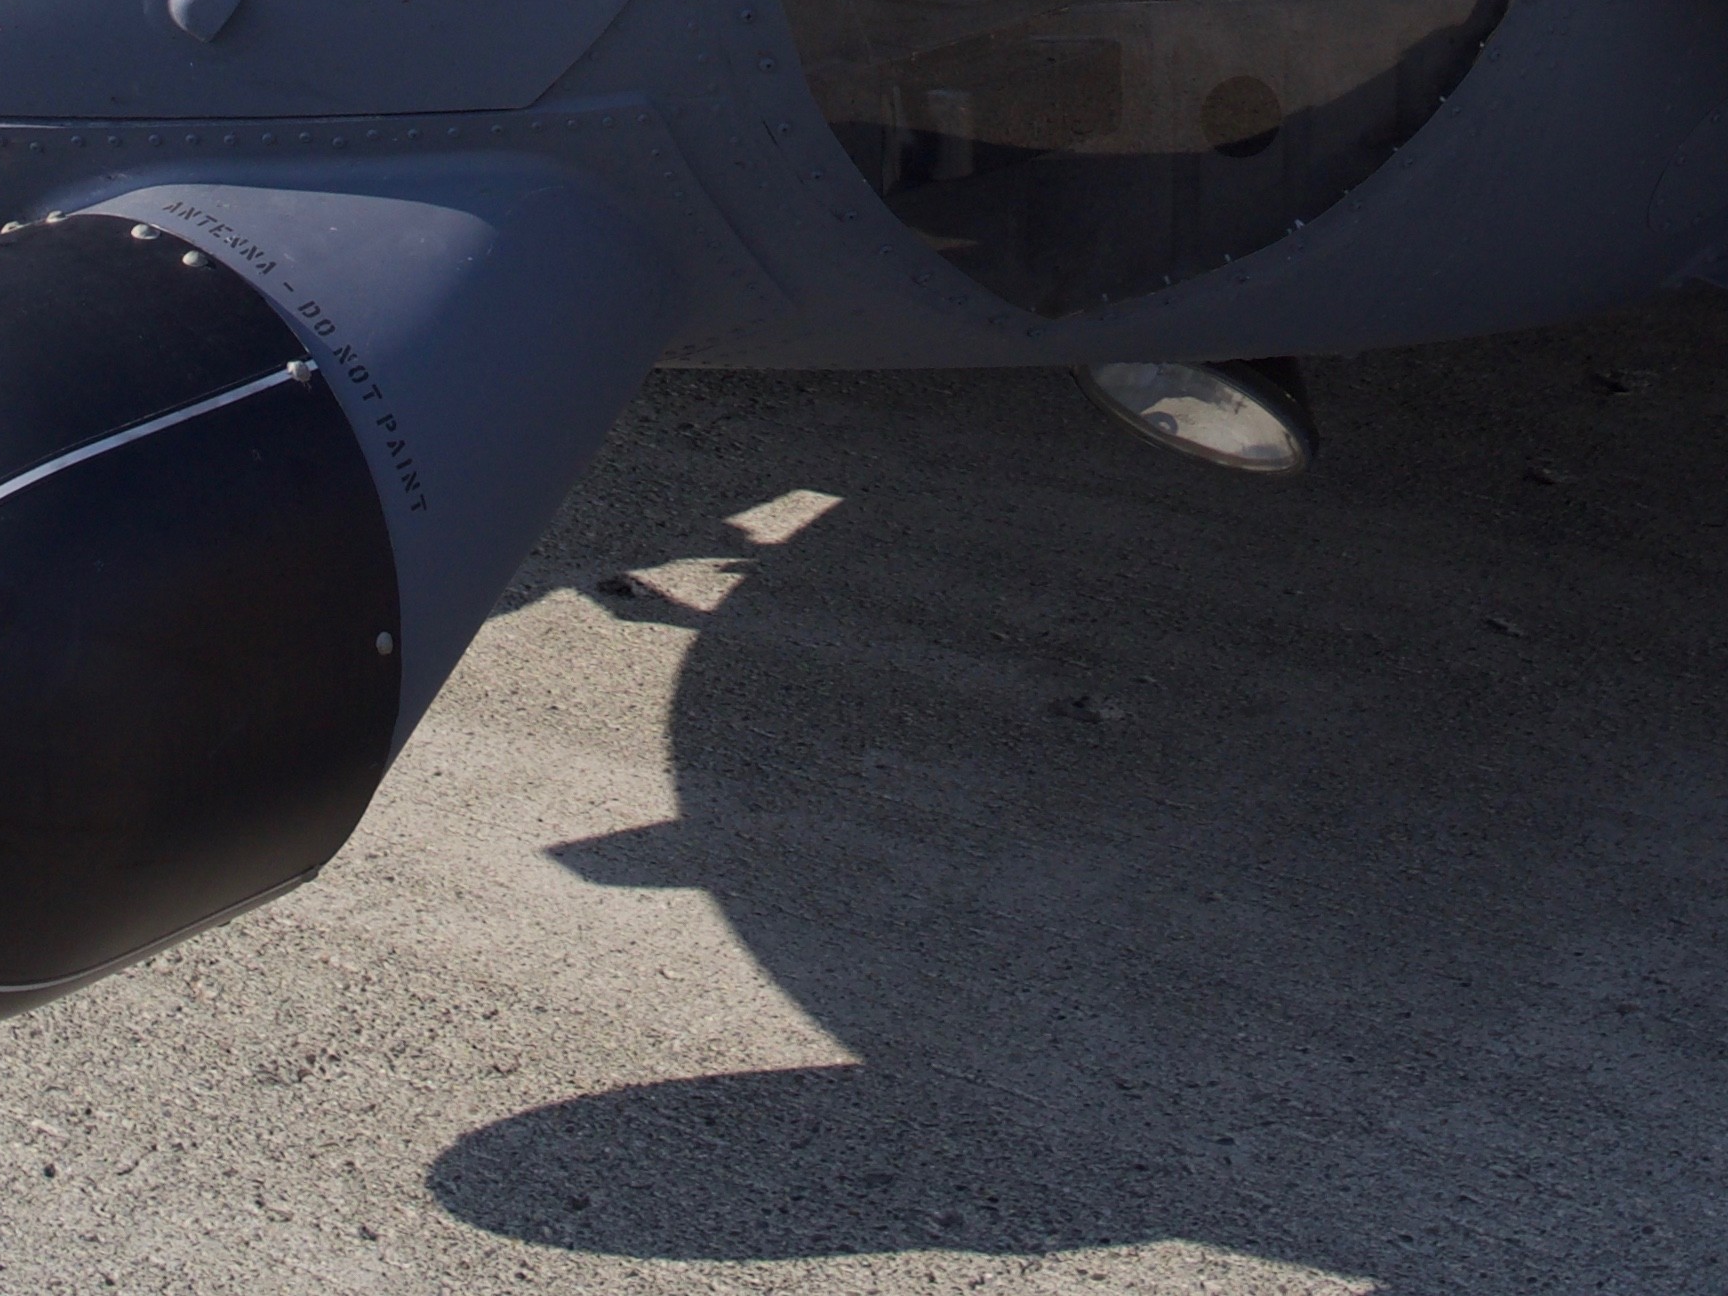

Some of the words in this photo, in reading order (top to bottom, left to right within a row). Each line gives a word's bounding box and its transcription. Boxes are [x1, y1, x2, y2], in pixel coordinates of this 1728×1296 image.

[161, 200, 279, 277] ANTENNA
[297, 300, 337, 339] DO
[332, 344, 384, 403] NOT
[375, 413, 428, 513] PAINT
